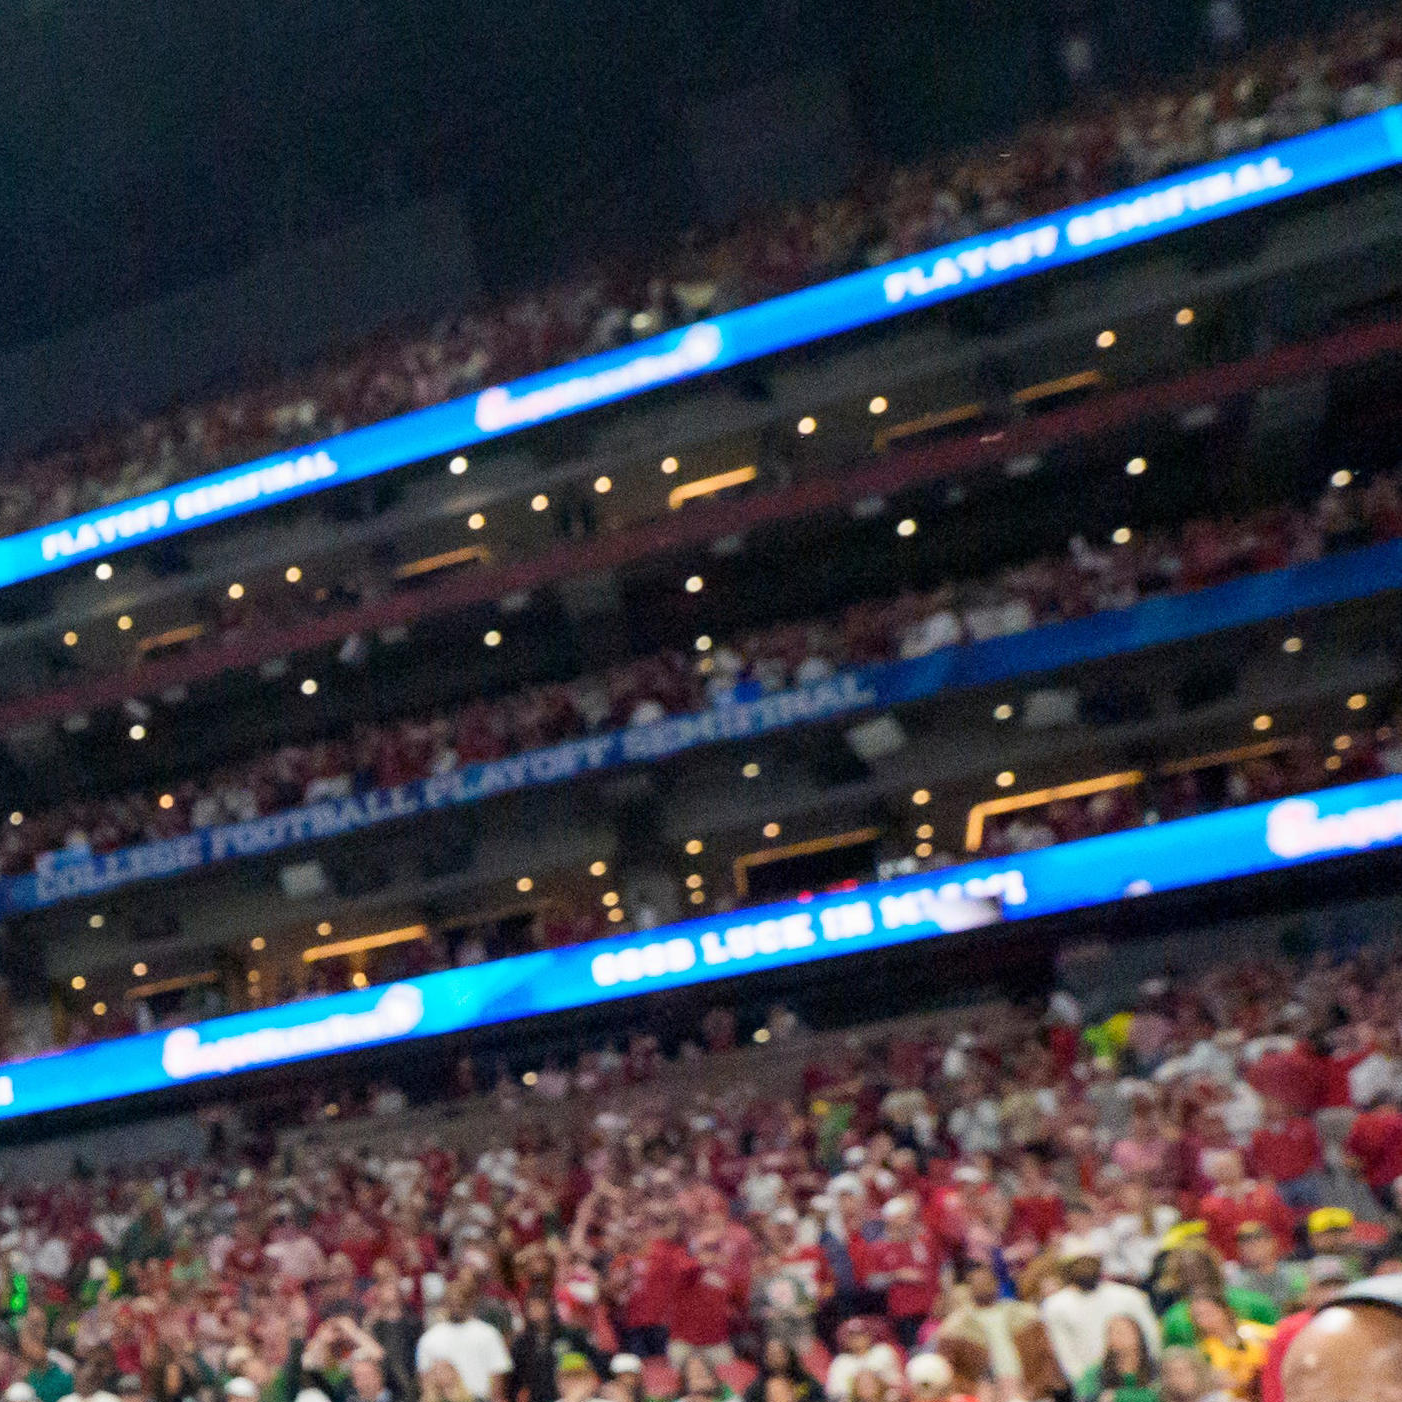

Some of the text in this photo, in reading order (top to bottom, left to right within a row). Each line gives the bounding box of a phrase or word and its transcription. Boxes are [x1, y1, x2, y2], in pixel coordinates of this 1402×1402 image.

[884, 158, 1292, 302] PLAYOFF SEMIFINAL
[42, 500, 169, 560] PLAYOFF
[700, 913, 815, 964] LUCK
[820, 902, 873, 940] IN
